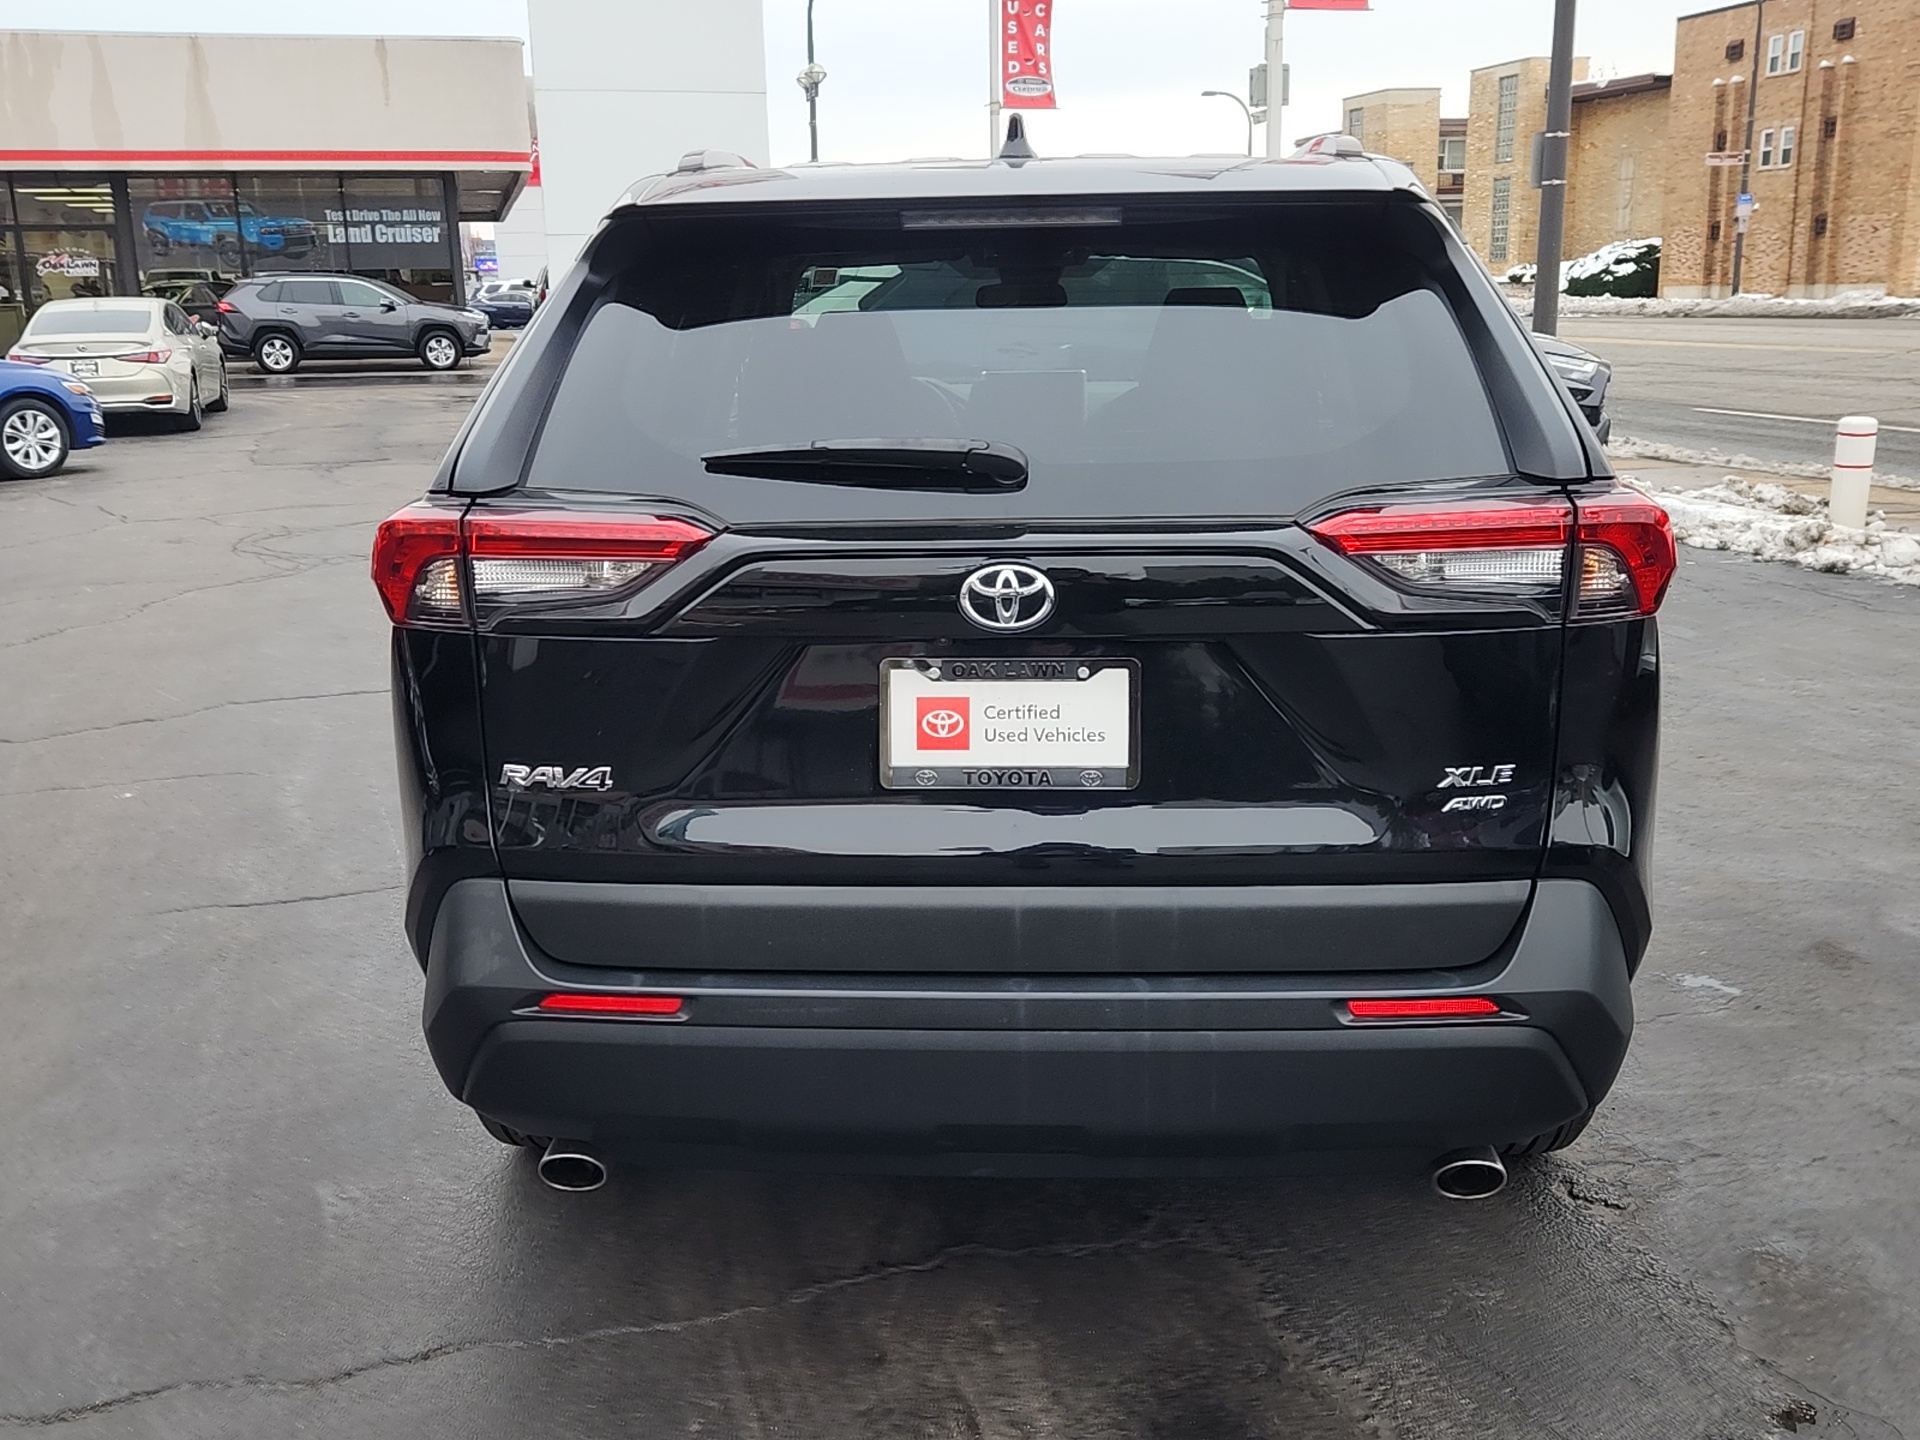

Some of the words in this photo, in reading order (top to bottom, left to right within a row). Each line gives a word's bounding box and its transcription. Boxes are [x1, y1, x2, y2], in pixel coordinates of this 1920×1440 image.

[1007, 1, 1020, 73] USED
[1034, 3, 1047, 74] CARS
[324, 209, 351, 222] Test
[352, 209, 380, 222] Drive
[380, 209, 401, 222] The
[402, 209, 417, 222] All
[418, 209, 441, 222] New
[327, 224, 373, 244] Land
[374, 224, 441, 243] Cruiser
[952, 662, 997, 678] OAK
[1005, 662, 1067, 678] LAWN
[983, 704, 1061, 720] Certified
[984, 727, 1028, 743] Used
[1035, 727, 1106, 743] Vehicles
[499, 763, 613, 791] RAV4
[962, 769, 1054, 786] TOYOTA
[1436, 764, 1516, 788] XLE
[1440, 795, 1508, 813] AWD
